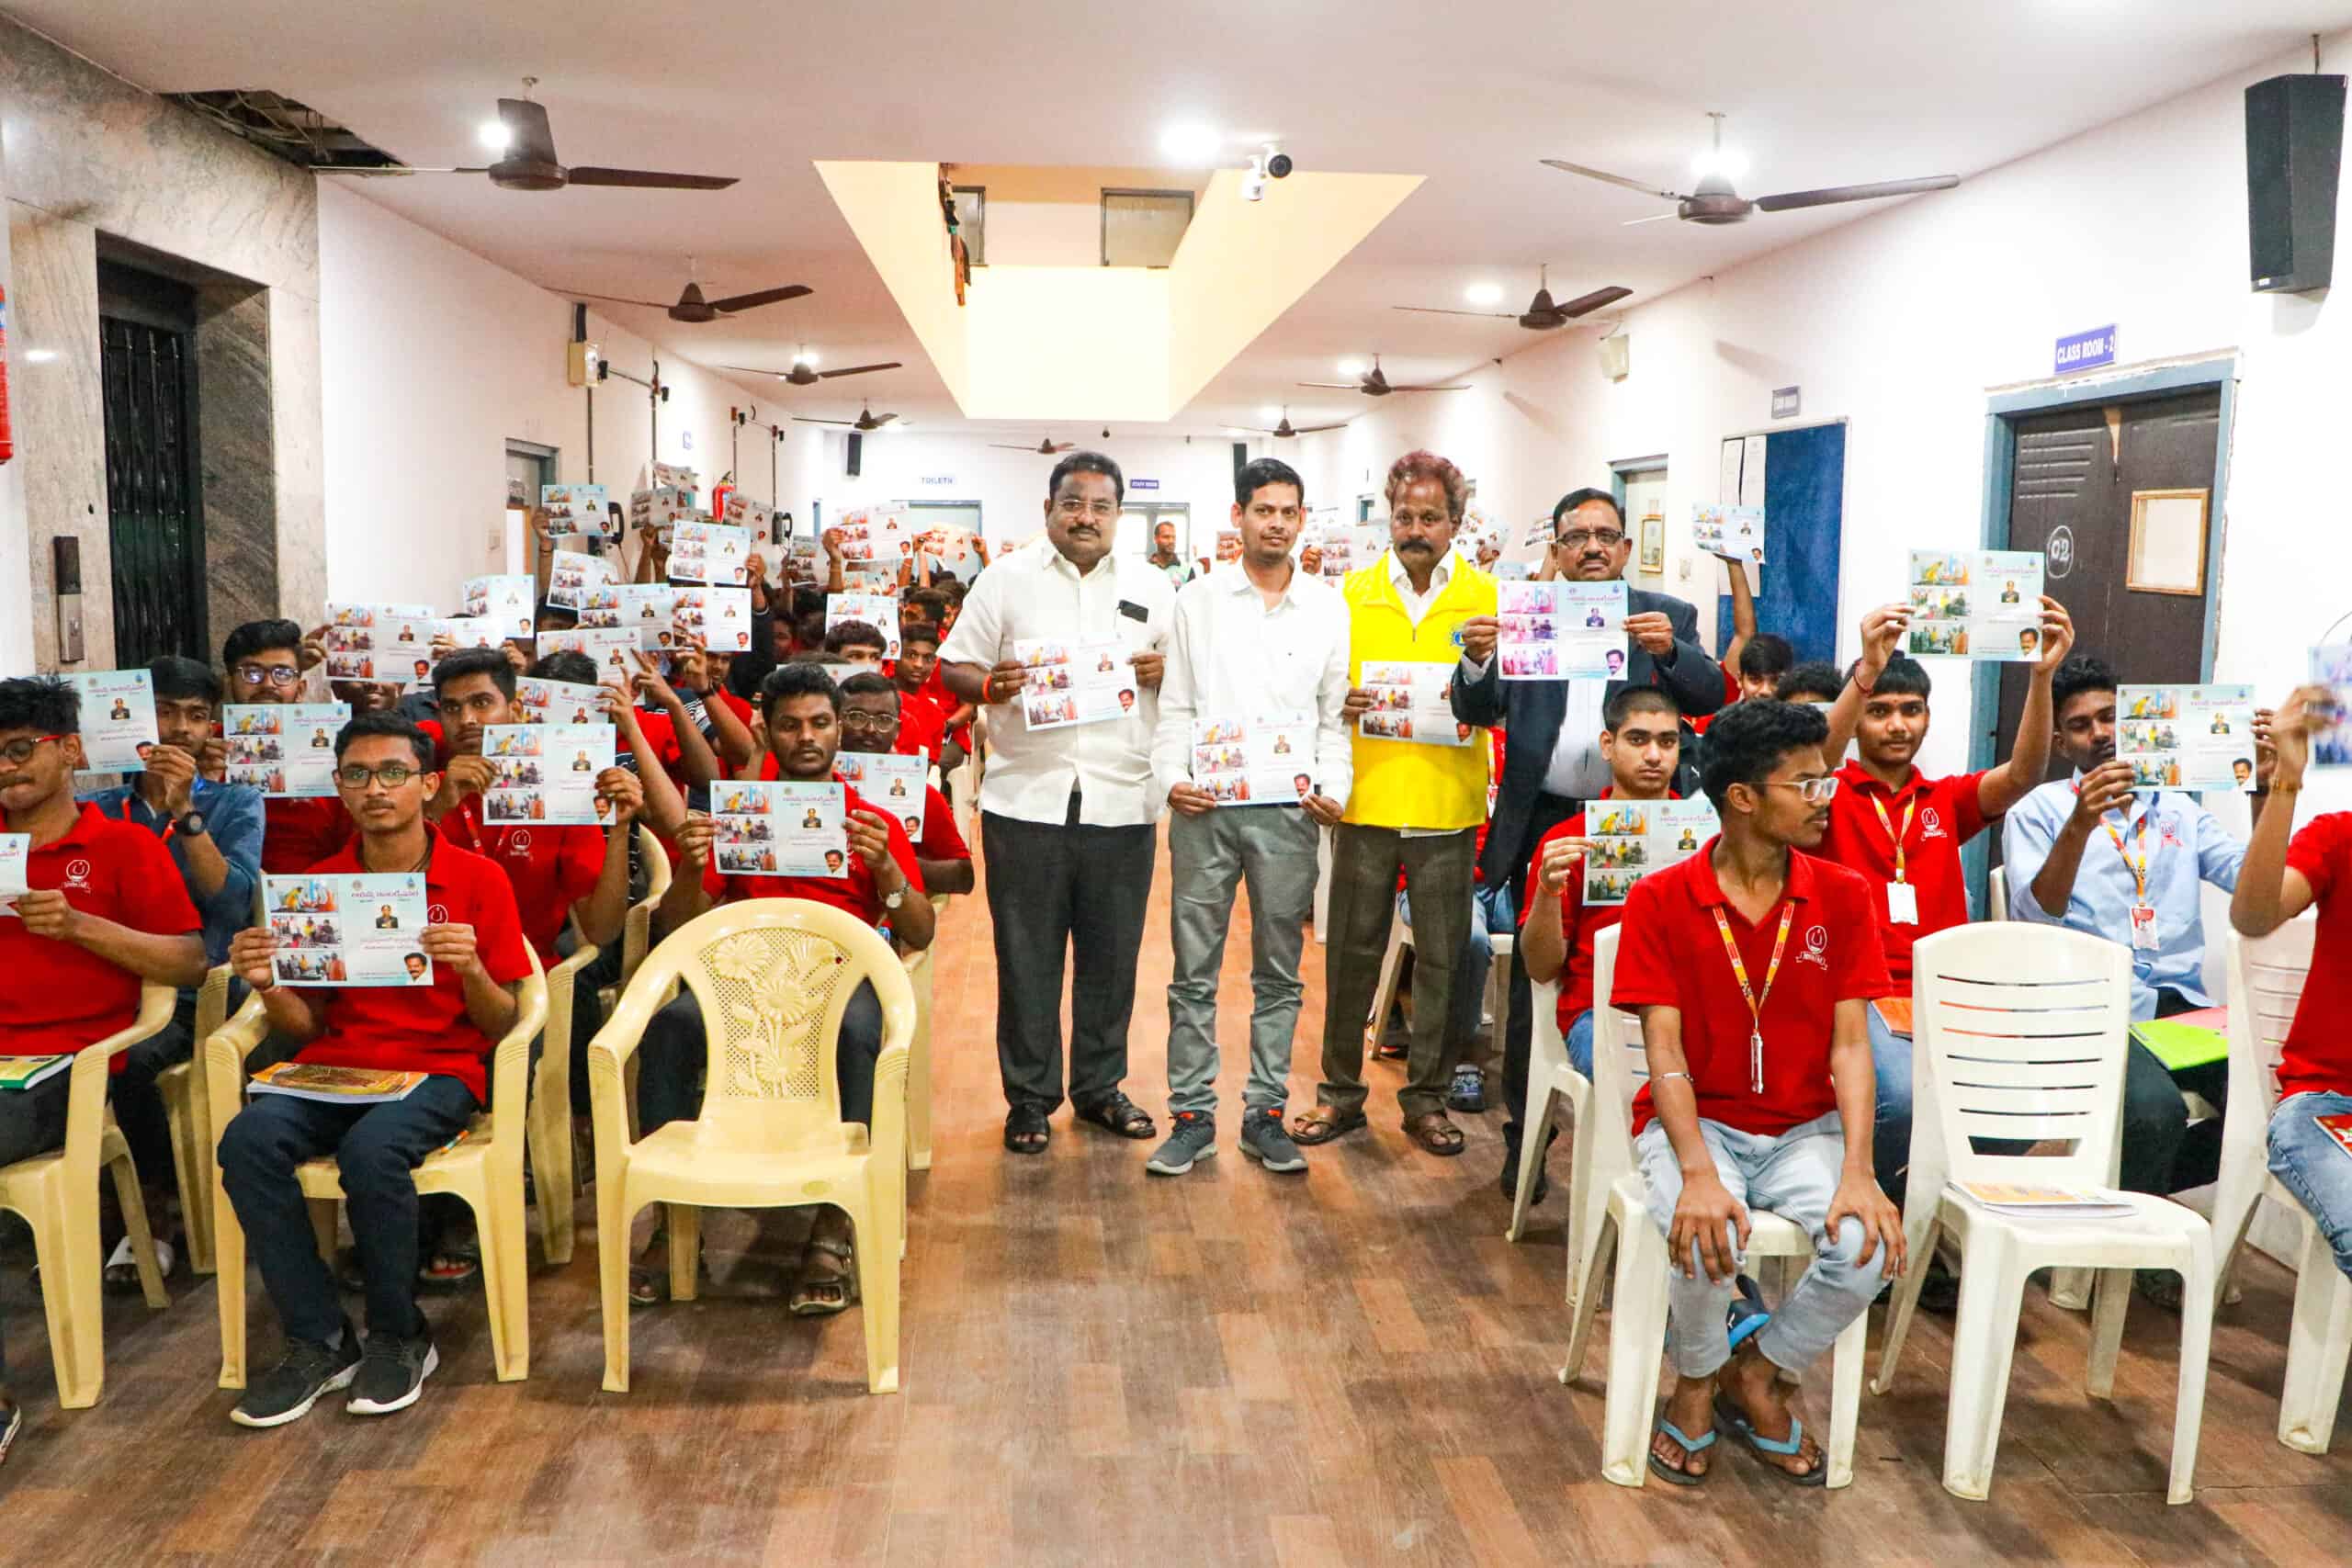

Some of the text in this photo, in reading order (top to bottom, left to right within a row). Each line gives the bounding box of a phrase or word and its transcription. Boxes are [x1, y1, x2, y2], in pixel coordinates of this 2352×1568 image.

[2058, 344, 2080, 364] CLASS
[2082, 337, 2104, 358] ROOM
[2051, 538, 2070, 561] 02
